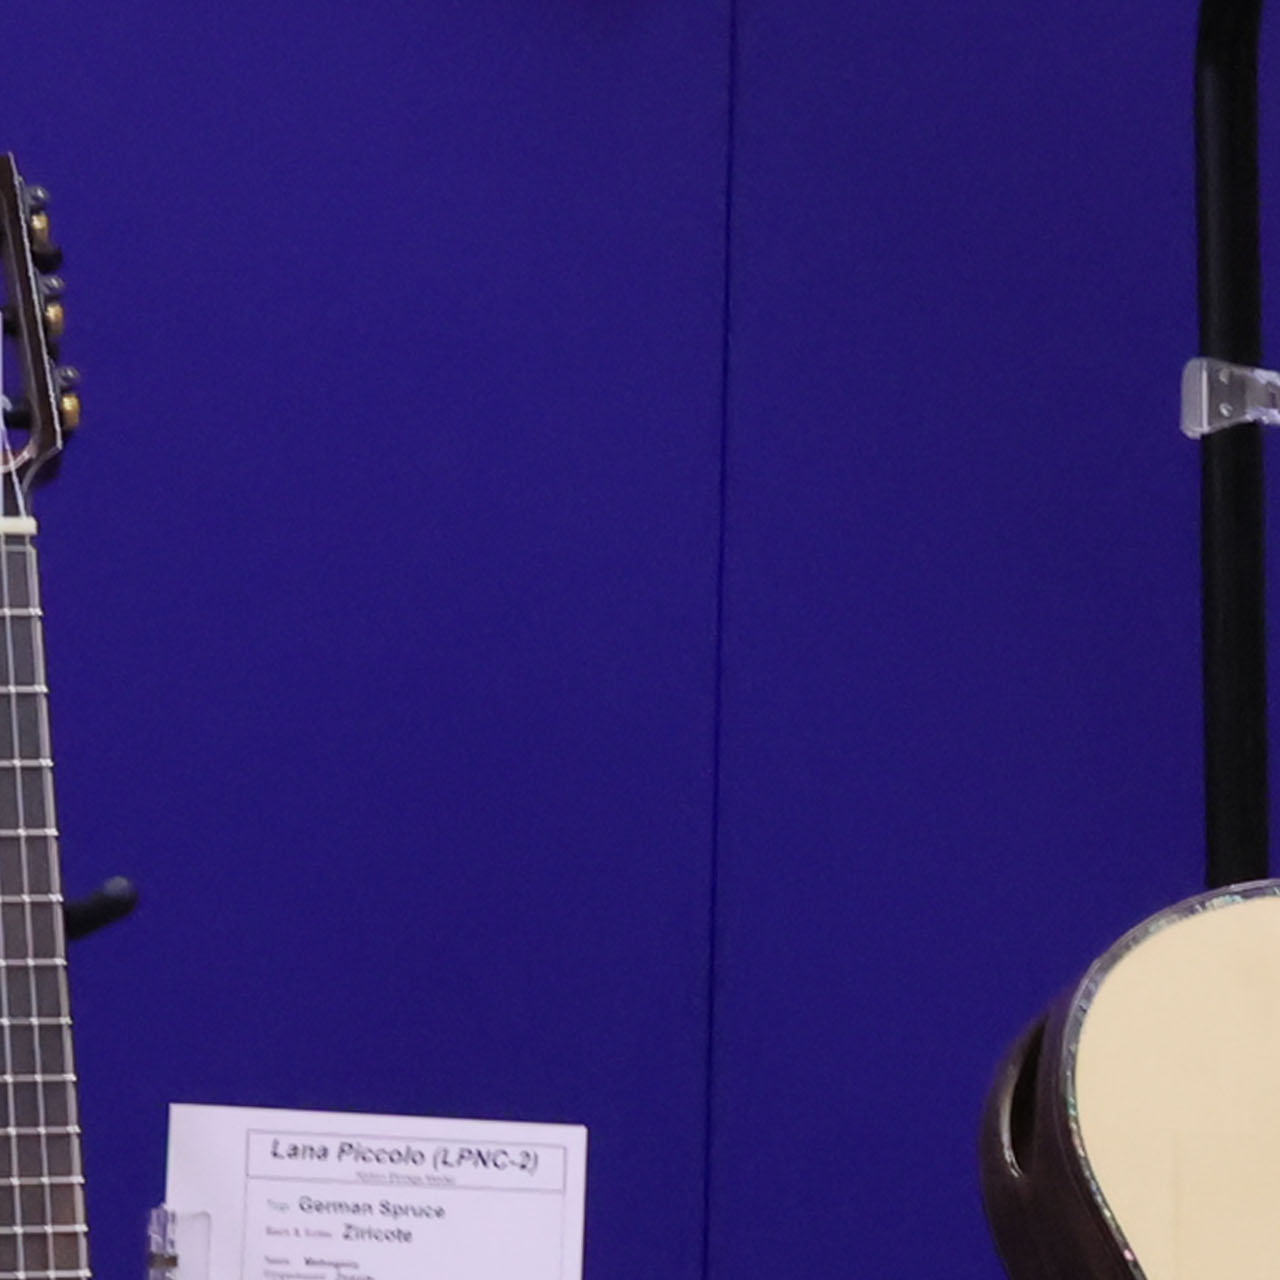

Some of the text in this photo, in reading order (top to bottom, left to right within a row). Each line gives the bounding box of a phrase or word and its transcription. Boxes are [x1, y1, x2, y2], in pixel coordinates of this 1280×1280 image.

[270, 1138, 539, 1177] Lana Piccolo (LPNC-2)
[298, 1195, 374, 1215] German
[379, 1199, 447, 1220] Spruce
[343, 1222, 414, 1244] Ziricote
